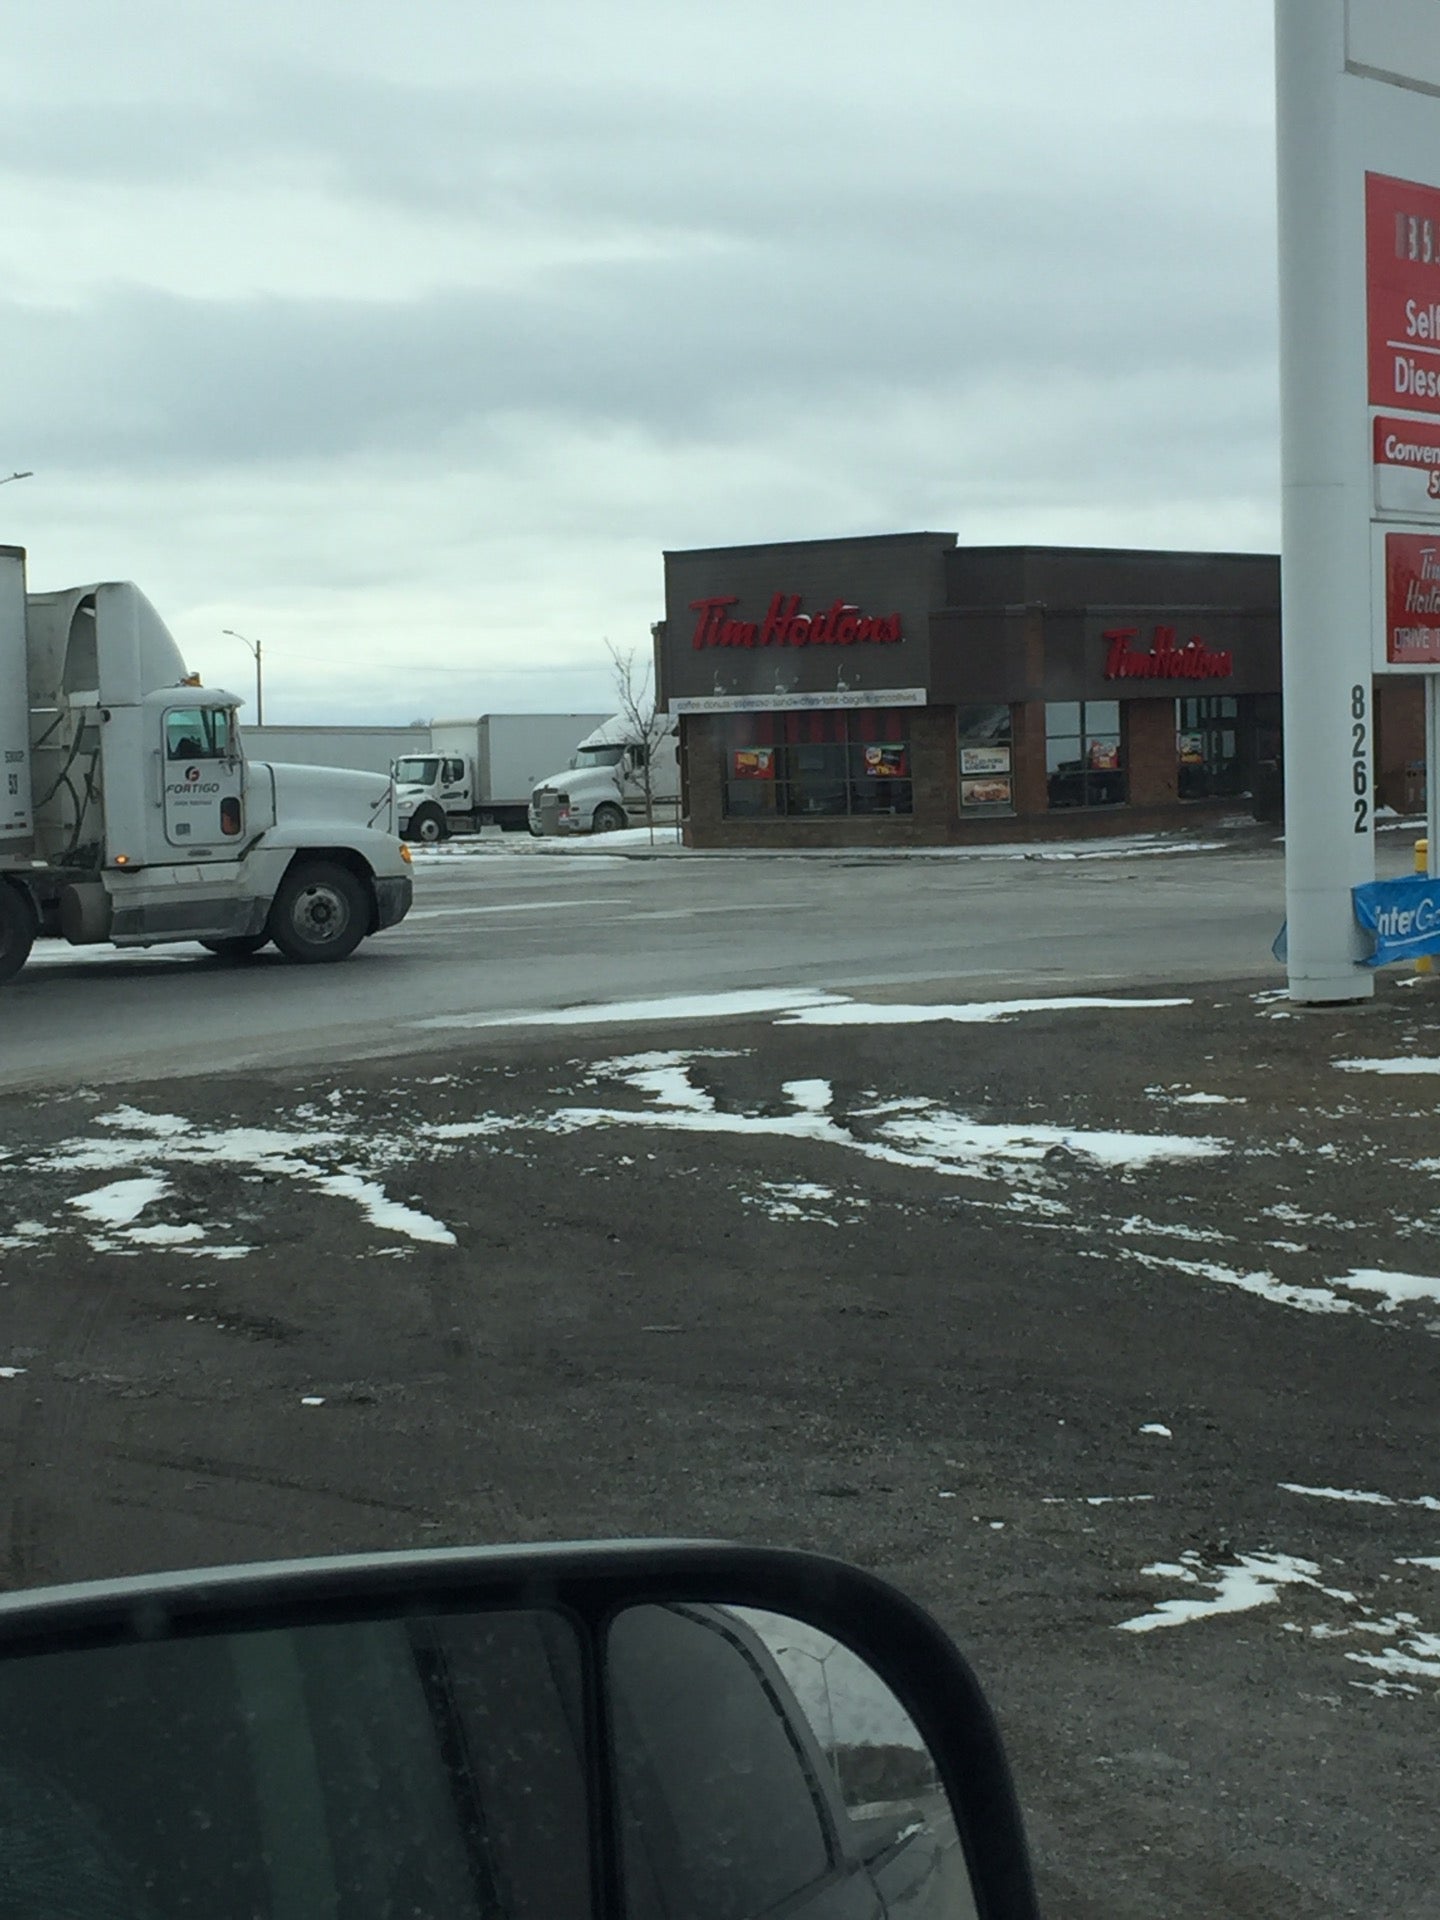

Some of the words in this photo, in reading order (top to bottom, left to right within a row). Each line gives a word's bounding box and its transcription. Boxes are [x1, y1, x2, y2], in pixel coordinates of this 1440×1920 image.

[1430, 470, 1440, 494] S
[688, 597, 758, 651] Tim
[759, 591, 903, 647] Hortons
[1394, 627, 1430, 649] DRIVE
[1102, 627, 1150, 679] Tim
[1150, 624, 1233, 679] Hortons
[1351, 684, 1368, 834] 8262
[166, 783, 220, 794] FORTIGO
